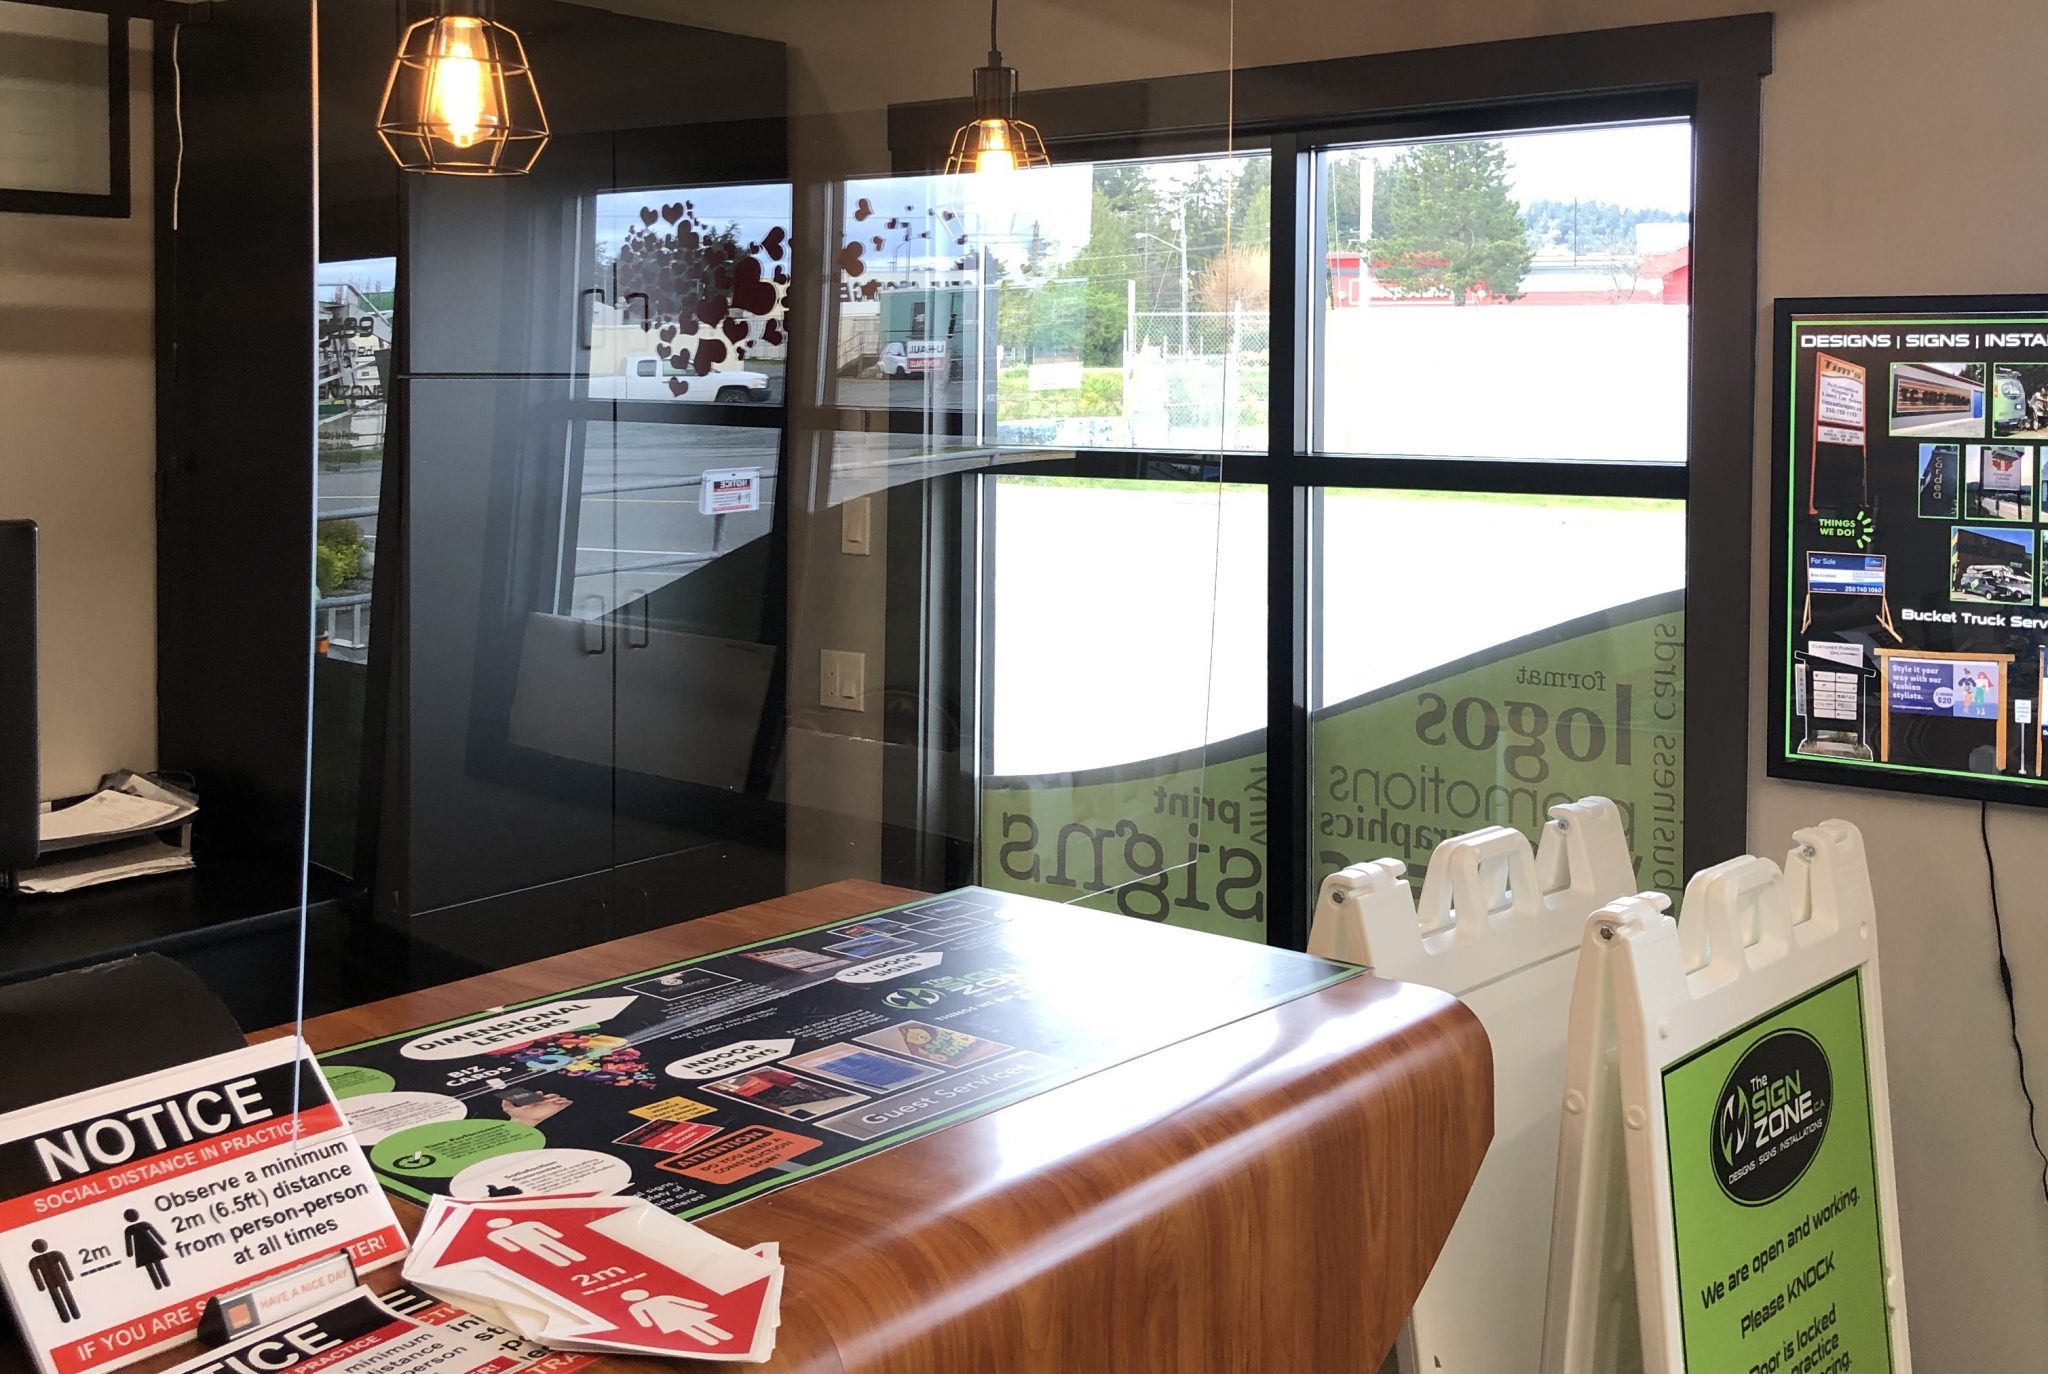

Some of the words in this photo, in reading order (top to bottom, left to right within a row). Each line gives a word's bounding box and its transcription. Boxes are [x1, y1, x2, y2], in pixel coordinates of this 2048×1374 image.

[1801, 334, 1891, 348] DESIGNS
[1906, 334, 1970, 347] SIGNS
[1985, 333, 2048, 347] INSTA
[1824, 360, 1862, 380] Tim's
[1819, 518, 1856, 528] THINGS
[1819, 527, 1835, 536] WE
[1836, 527, 1855, 537] DO!
[1810, 557, 1822, 565] For
[1823, 558, 1836, 566] Sale
[1901, 608, 1957, 624] Bucket
[1961, 612, 2006, 626] Truck
[1892, 664, 1912, 674] Style
[1892, 681, 1921, 690] fashion
[845, 953, 919, 977] OUTDOOR
[873, 961, 924, 977] SIGNS
[414, 1003, 591, 1051] DIMENSIONAL
[473, 1018, 570, 1046] LETTERS
[447, 1065, 486, 1078] BIZ
[681, 1044, 761, 1069] INDOOR
[695, 1048, 780, 1075] DISPLAYS
[446, 1066, 513, 1087] CARDS
[1750, 1074, 1768, 1092] The
[862, 1096, 939, 1124] Guest
[934, 1063, 1034, 1099] Services
[1752, 1069, 1801, 1120] SIGN
[34, 1077, 273, 1183] NOTICE
[1753, 1090, 1813, 1149] ZONE
[677, 1131, 764, 1168] ATTENTION
[700, 1162, 719, 1172] DO
[720, 1152, 744, 1164] YOU
[743, 1140, 773, 1155] NEED
[713, 1140, 794, 1175] CONSTRUCTION
[748, 1153, 782, 1169] SIGN?
[1728, 1159, 1756, 1185] DESIGNS
[1758, 1146, 1777, 1166] SIGNS
[1779, 1118, 1823, 1152] INSTALLATIONS
[34, 1180, 107, 1213] SOCIAL
[109, 1151, 198, 1191] DISTANCE
[202, 1144, 221, 1161] IN
[222, 1119, 307, 1154] PRACTICE
[154, 1176, 241, 1212] Observe
[244, 1170, 258, 1184] a
[260, 1140, 348, 1178] minimum
[171, 1212, 205, 1233] 2m
[273, 1164, 352, 1200] distance
[175, 1231, 226, 1258] from
[230, 1182, 369, 1244] person-person
[78, 1245, 112, 1265] 2m
[233, 1245, 255, 1266] at
[258, 1234, 281, 1256] all
[283, 1217, 339, 1247] times
[349, 1235, 388, 1262] TER!
[1701, 1280, 1725, 1309] We
[1728, 1264, 1749, 1291] are
[1752, 1238, 1784, 1274] open
[1787, 1214, 1810, 1248] and
[1812, 1186, 1860, 1230] working.
[260, 1291, 288, 1310] HAVE
[291, 1286, 300, 1298] A
[301, 1275, 327, 1293] NICE
[328, 1268, 348, 1284] DAY
[570, 1264, 625, 1288] 2m
[1740, 1292, 1785, 1339] Please
[1786, 1251, 1836, 1304] KNOCK
[77, 1341, 97, 1361] IF
[100, 1323, 147, 1351] YOU
[152, 1307, 193, 1335] ARE
[1783, 1340, 1795, 1362] is
[1796, 1302, 1837, 1351] locked
[344, 1332, 434, 1374] minimum
